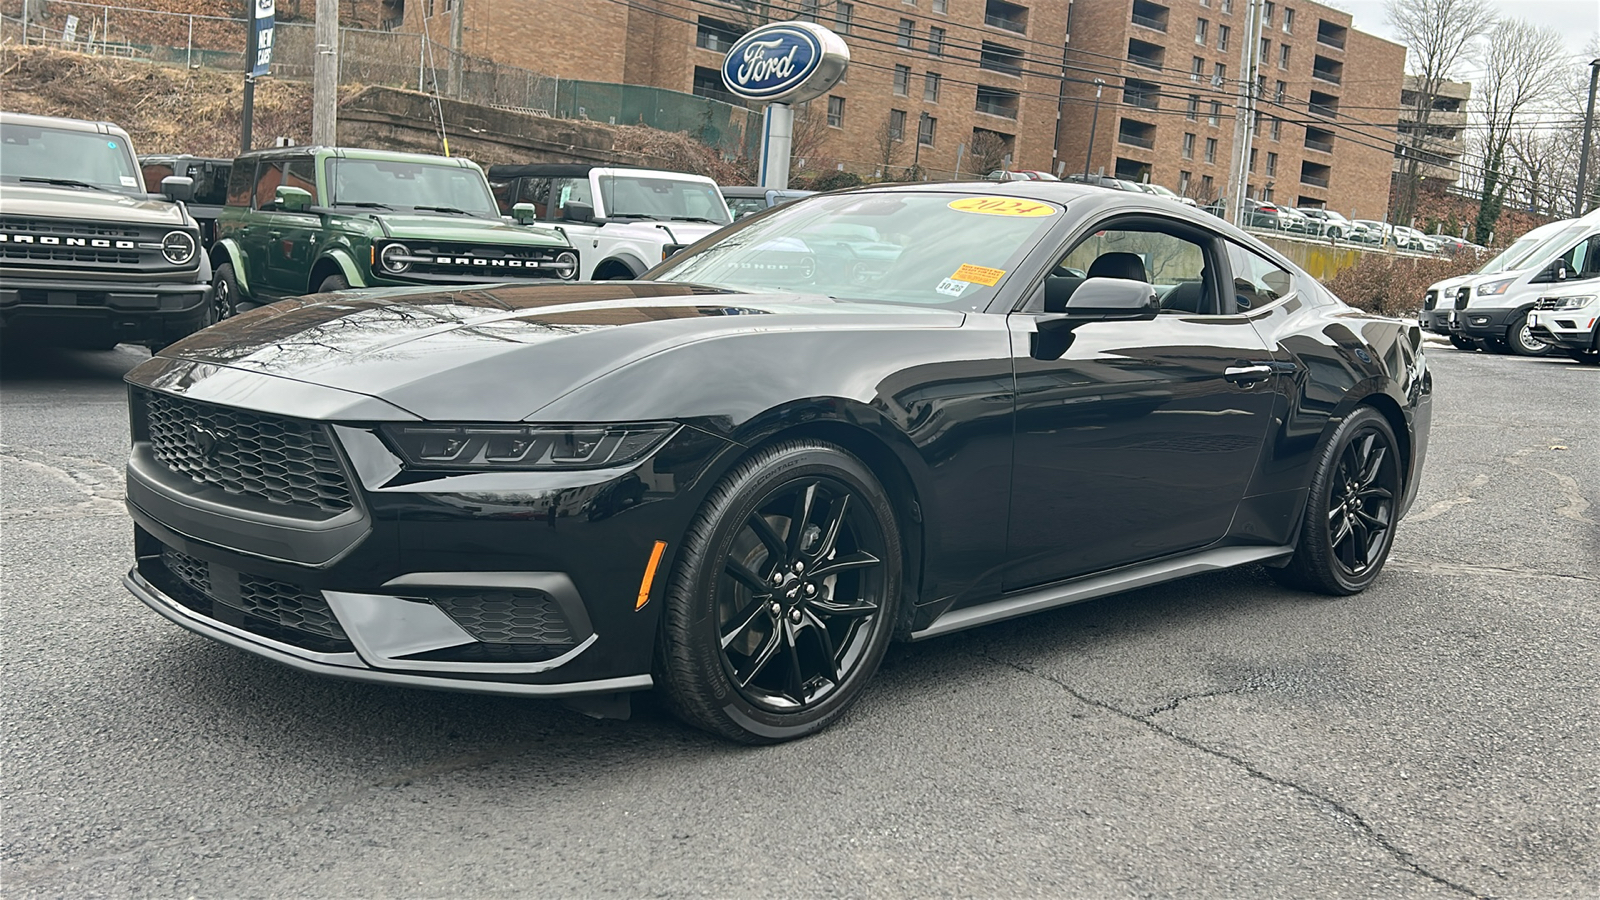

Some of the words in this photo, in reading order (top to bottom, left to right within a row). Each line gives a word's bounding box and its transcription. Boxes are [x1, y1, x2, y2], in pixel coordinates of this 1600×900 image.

[258, 28, 273, 49] NEW
[257, 48, 271, 66] CARS
[738, 38, 798, 85] Ford
[959, 200, 1045, 214] 2024
[437, 257, 539, 268] BRONCO
